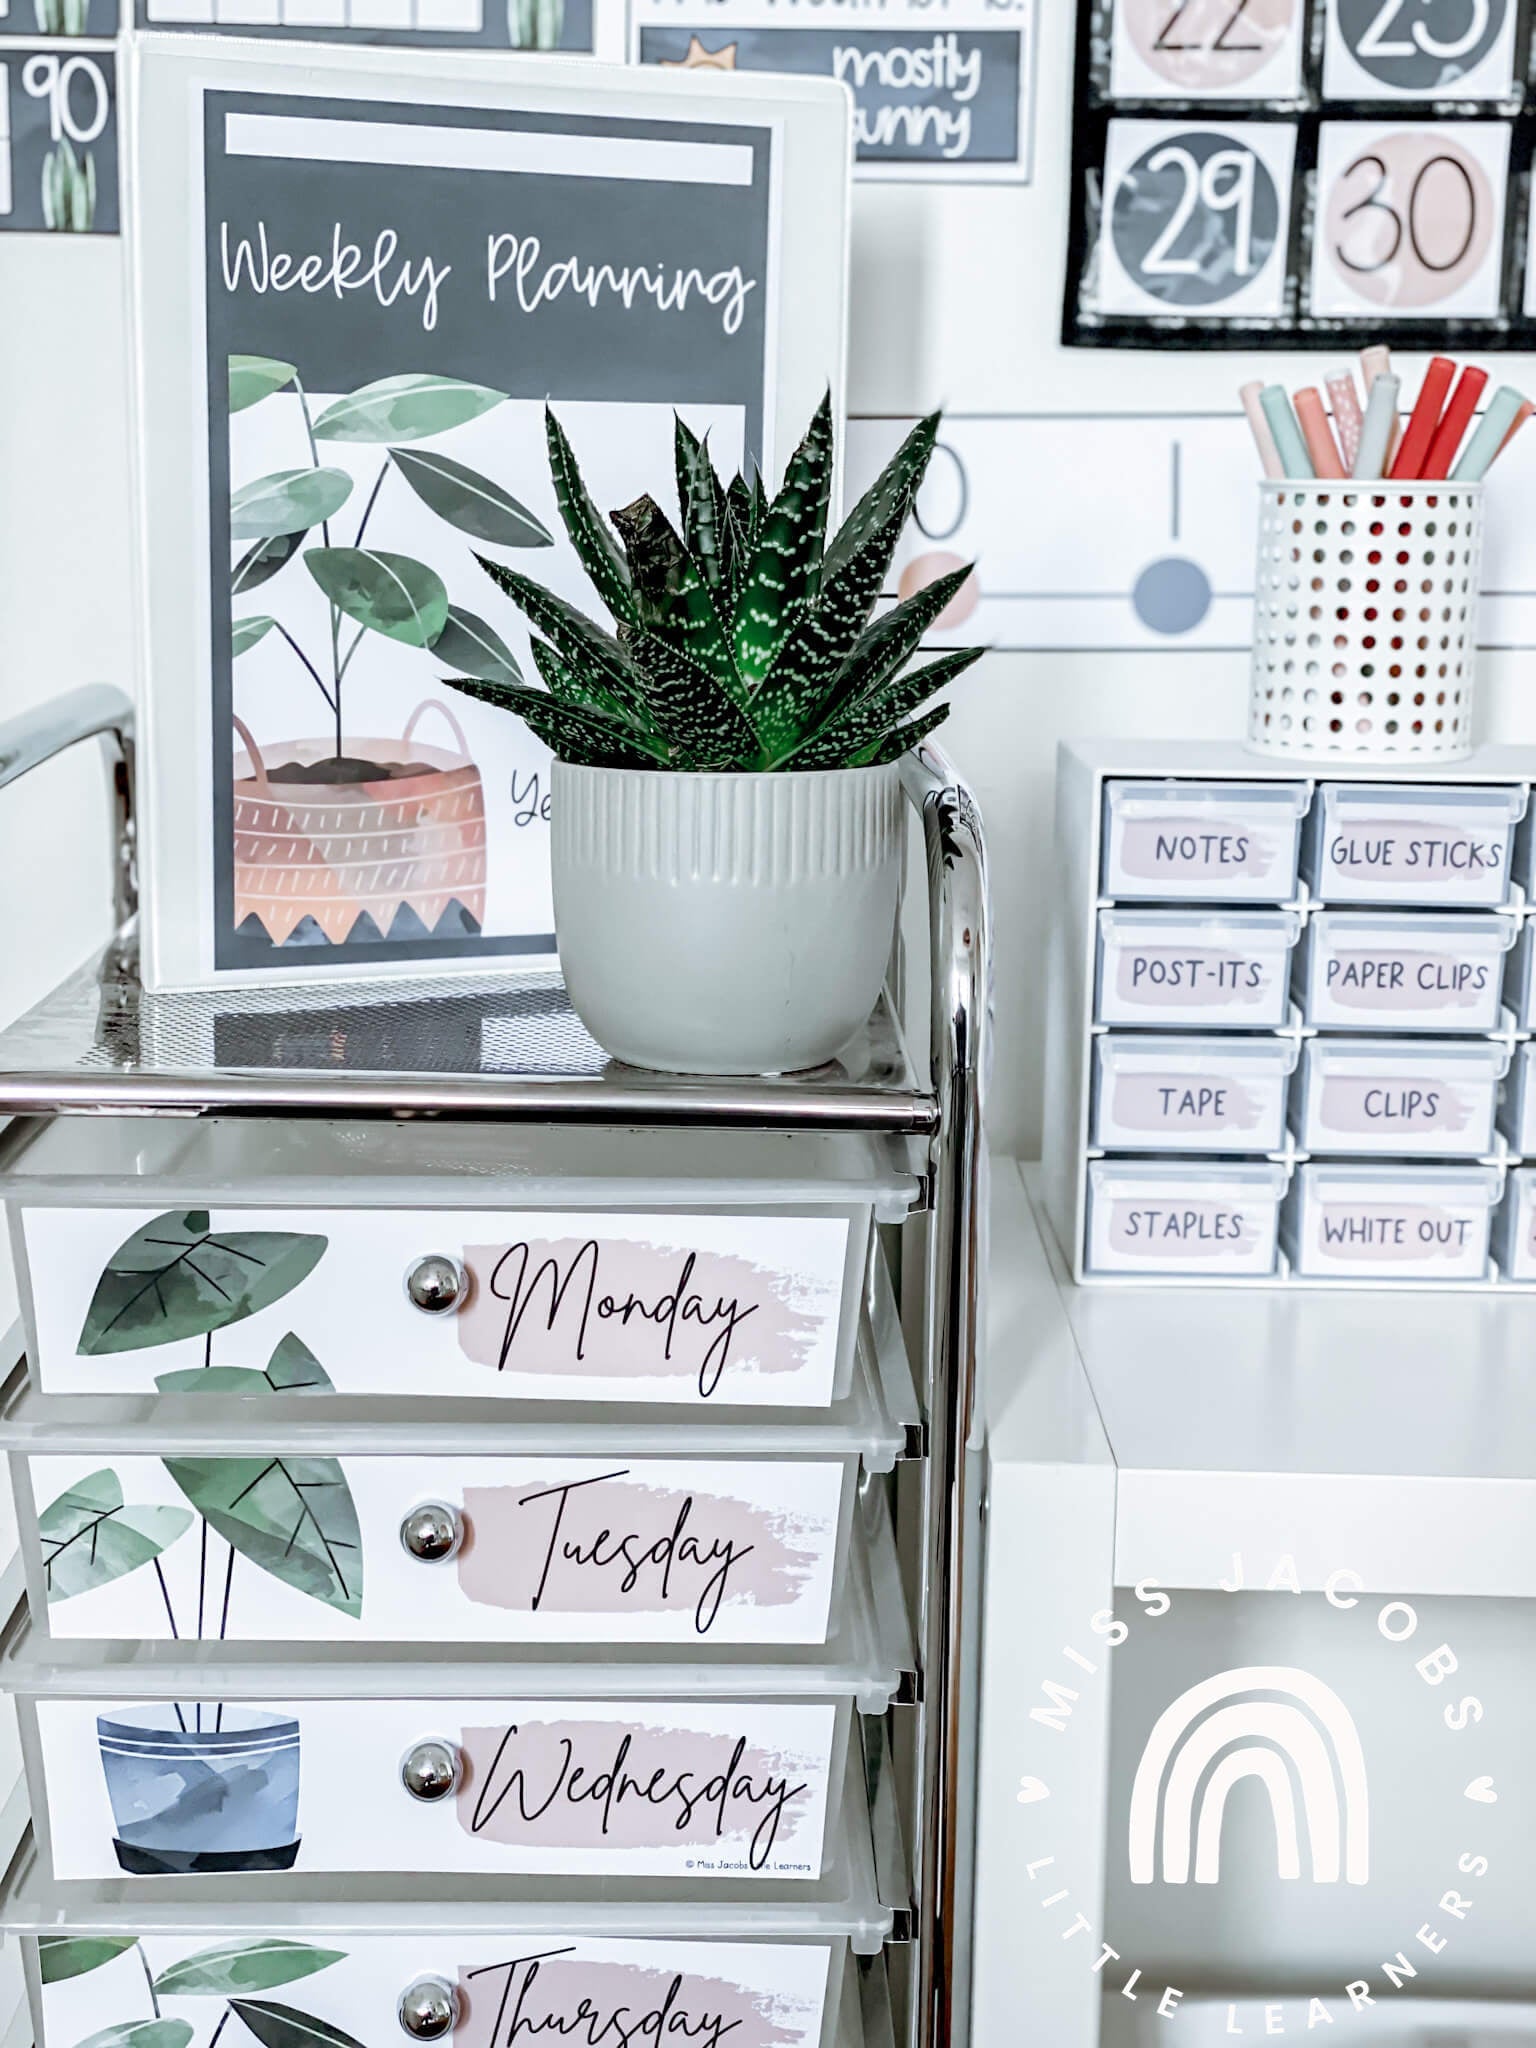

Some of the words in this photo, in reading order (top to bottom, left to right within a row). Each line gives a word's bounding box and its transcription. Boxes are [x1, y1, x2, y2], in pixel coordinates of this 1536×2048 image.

[832, 34, 982, 101] mostly
[22, 54, 109, 143] 90
[1141, 146, 1256, 276] 29
[1336, 155, 1476, 272] 30
[220, 221, 452, 331] Weekly
[487, 233, 757, 334] Planning
[1155, 835, 1250, 865] NOTES
[1331, 836, 1396, 867] GLUE
[1405, 841, 1503, 870] STICKS
[1132, 957, 1263, 988] POST-ITS
[1326, 959, 1405, 990] PAPER
[1417, 963, 1489, 992] CLIPS
[1158, 1087, 1228, 1117] TAPE
[1364, 1090, 1440, 1120] CLIPS
[1124, 1211, 1244, 1241] STAPLES
[1323, 1216, 1406, 1245] WHITE
[1418, 1219, 1473, 1247] OUT
[490, 1240, 759, 1398] Monday
[518, 1469, 755, 1634] Tuesday
[471, 1725, 808, 1871] Wednesday
[717, 1859, 748, 1870] Jacobs
[773, 1860, 812, 1872] Learners
